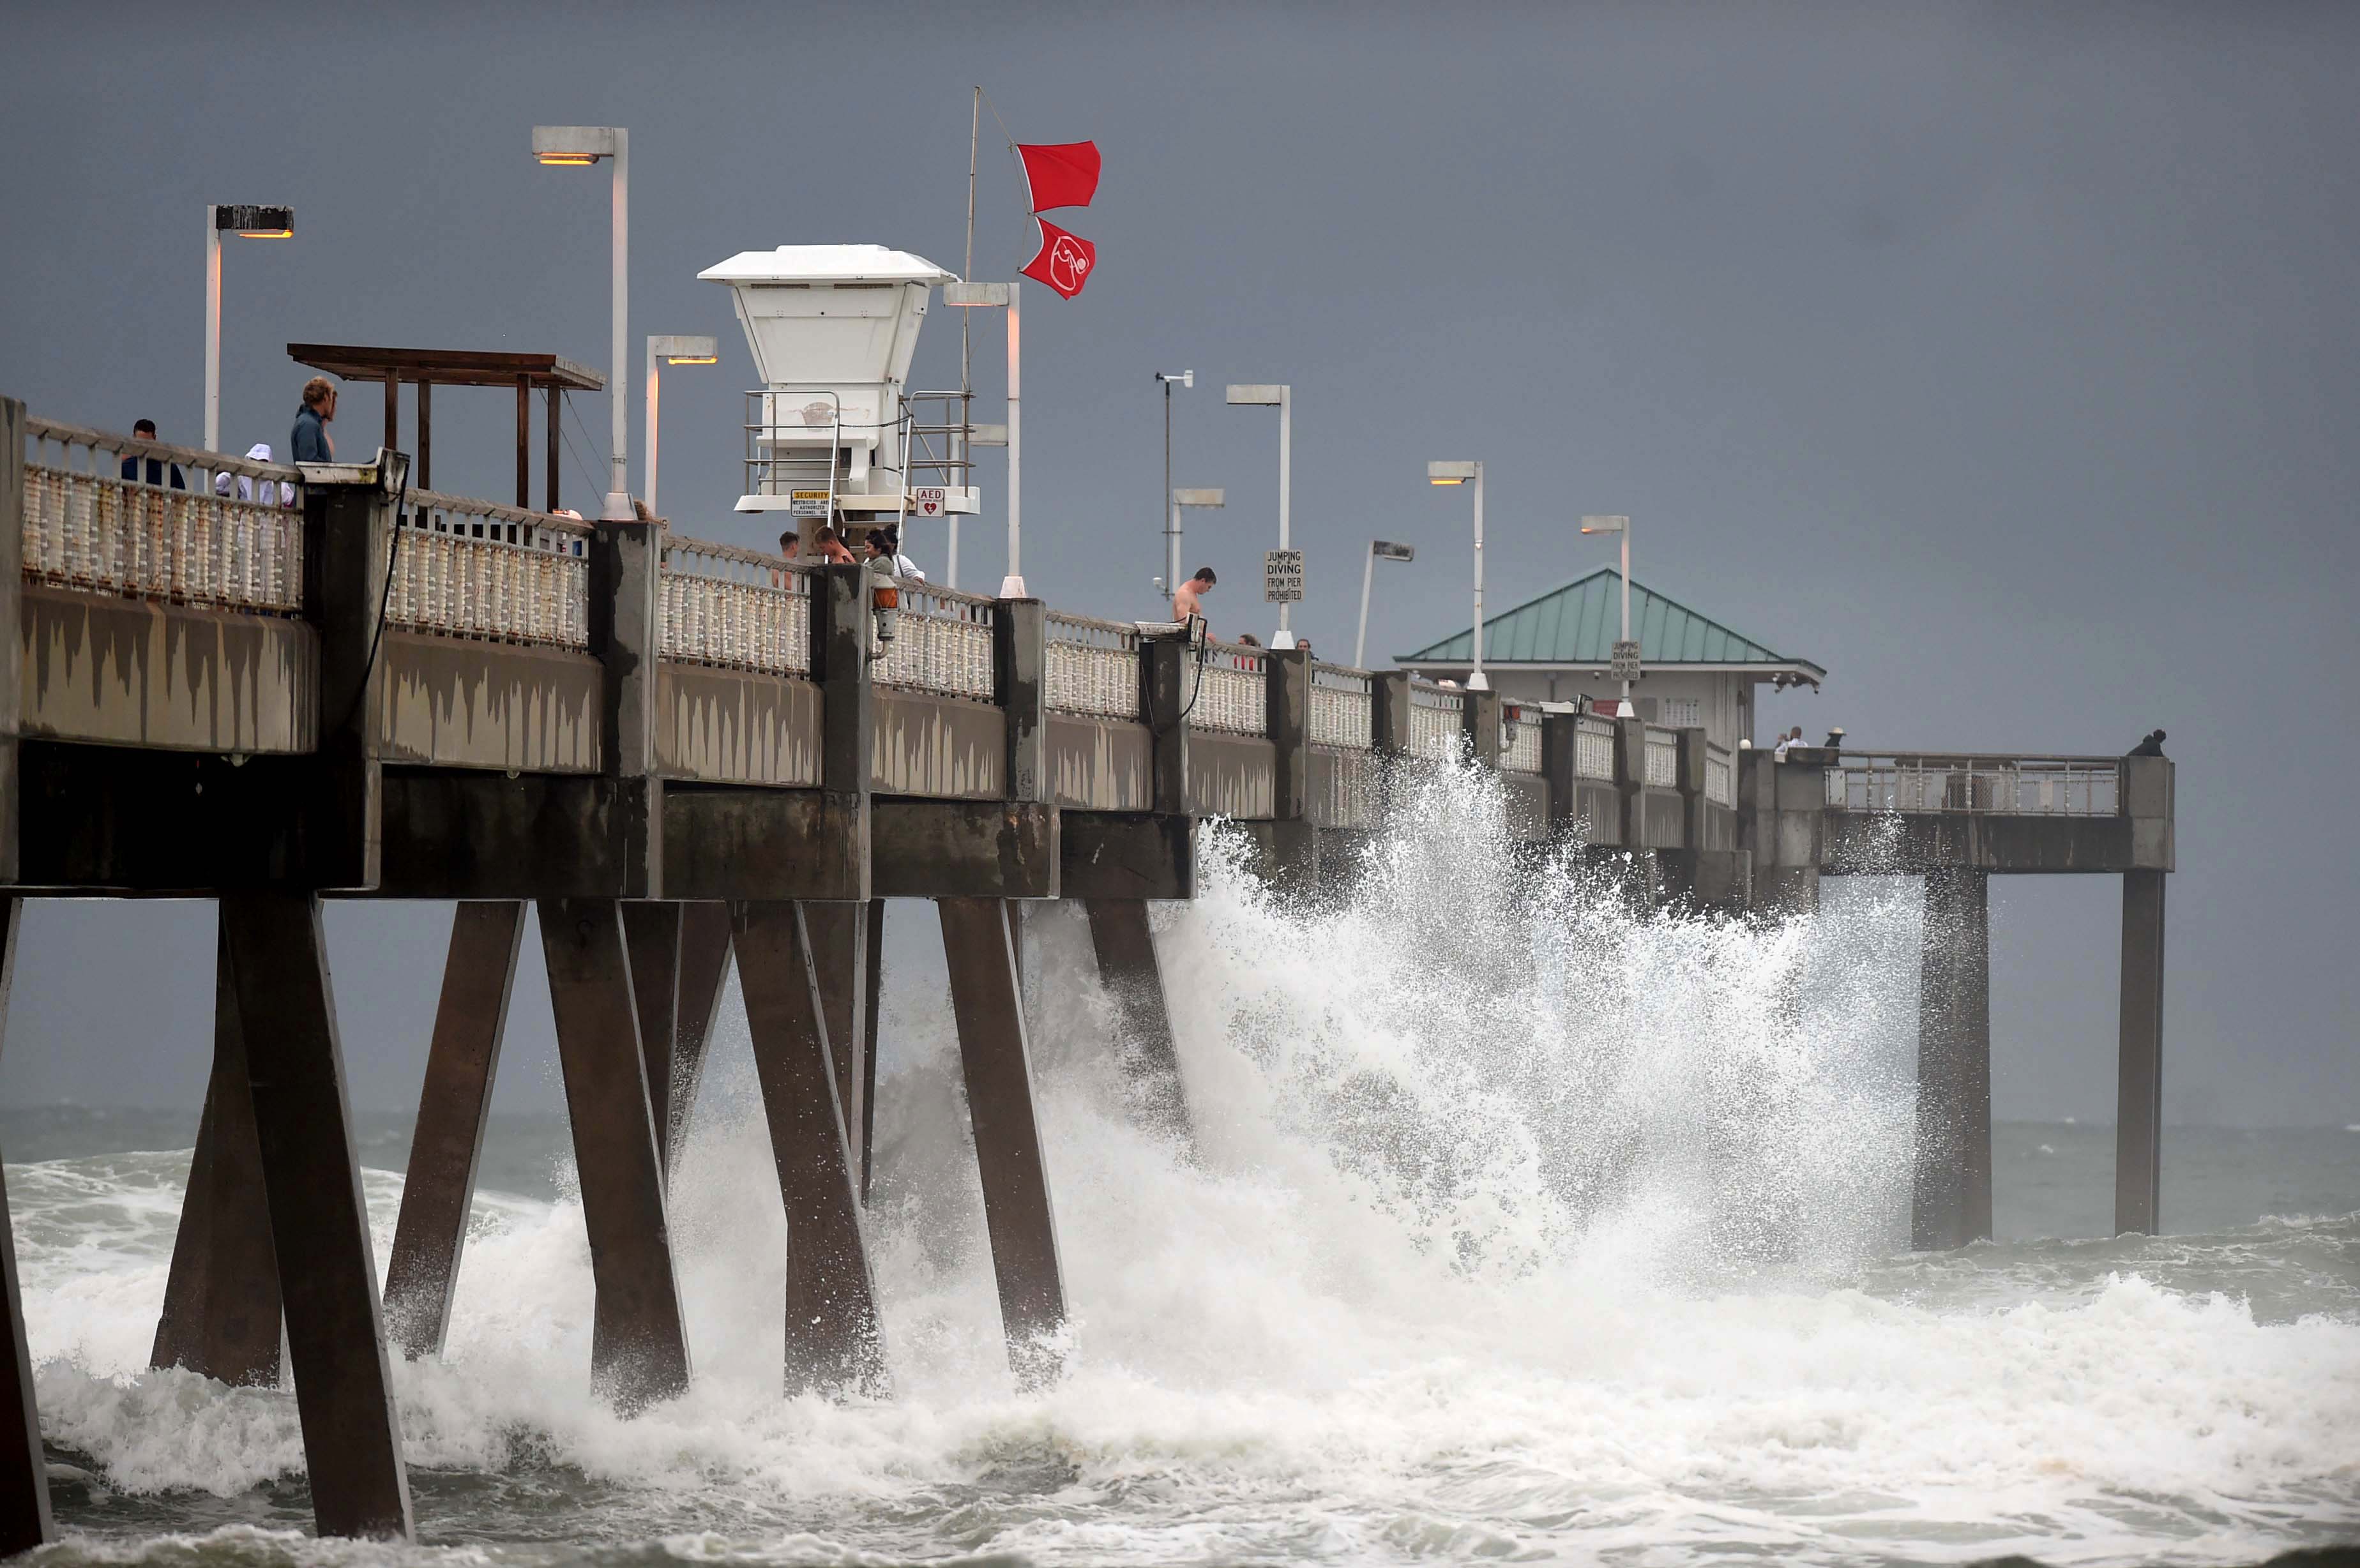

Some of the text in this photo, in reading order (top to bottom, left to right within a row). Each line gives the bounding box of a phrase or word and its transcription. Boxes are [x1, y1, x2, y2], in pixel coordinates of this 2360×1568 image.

[921, 490, 941, 499] AED
[1267, 552, 1301, 561] JUMPING
[1267, 564, 1301, 574] DIVING
[1267, 577, 1301, 587] FROM PIER
[1268, 591, 1301, 600] PROHIBITED
